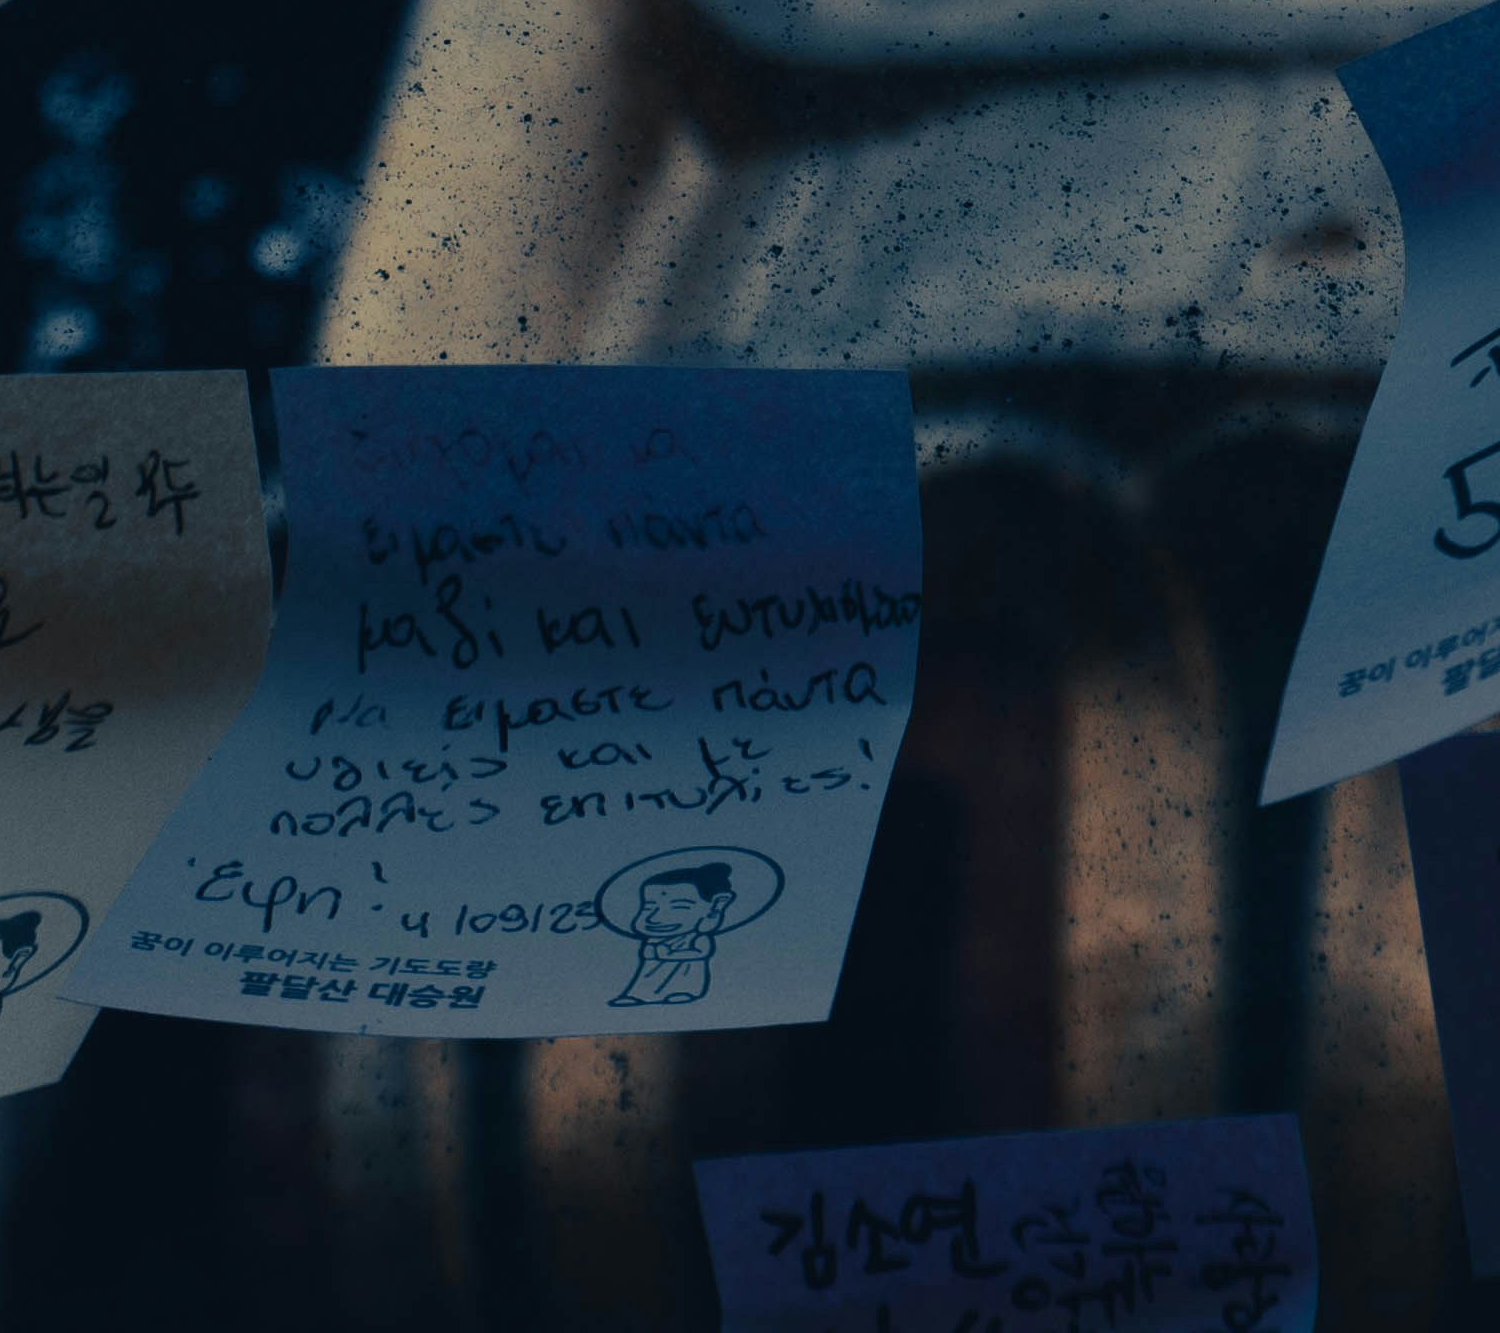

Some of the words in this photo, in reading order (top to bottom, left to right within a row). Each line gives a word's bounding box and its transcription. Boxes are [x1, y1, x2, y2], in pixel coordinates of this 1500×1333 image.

[536, 605, 642, 657] και
[1336, 655, 1398, 699] 꿈이
[128, 930, 196, 959] 꿈이
[203, 940, 360, 974] 이루어지는
[368, 951, 498, 981] 기도도량
[238, 970, 359, 1003] 팔달산
[367, 980, 487, 1010] 대승원
